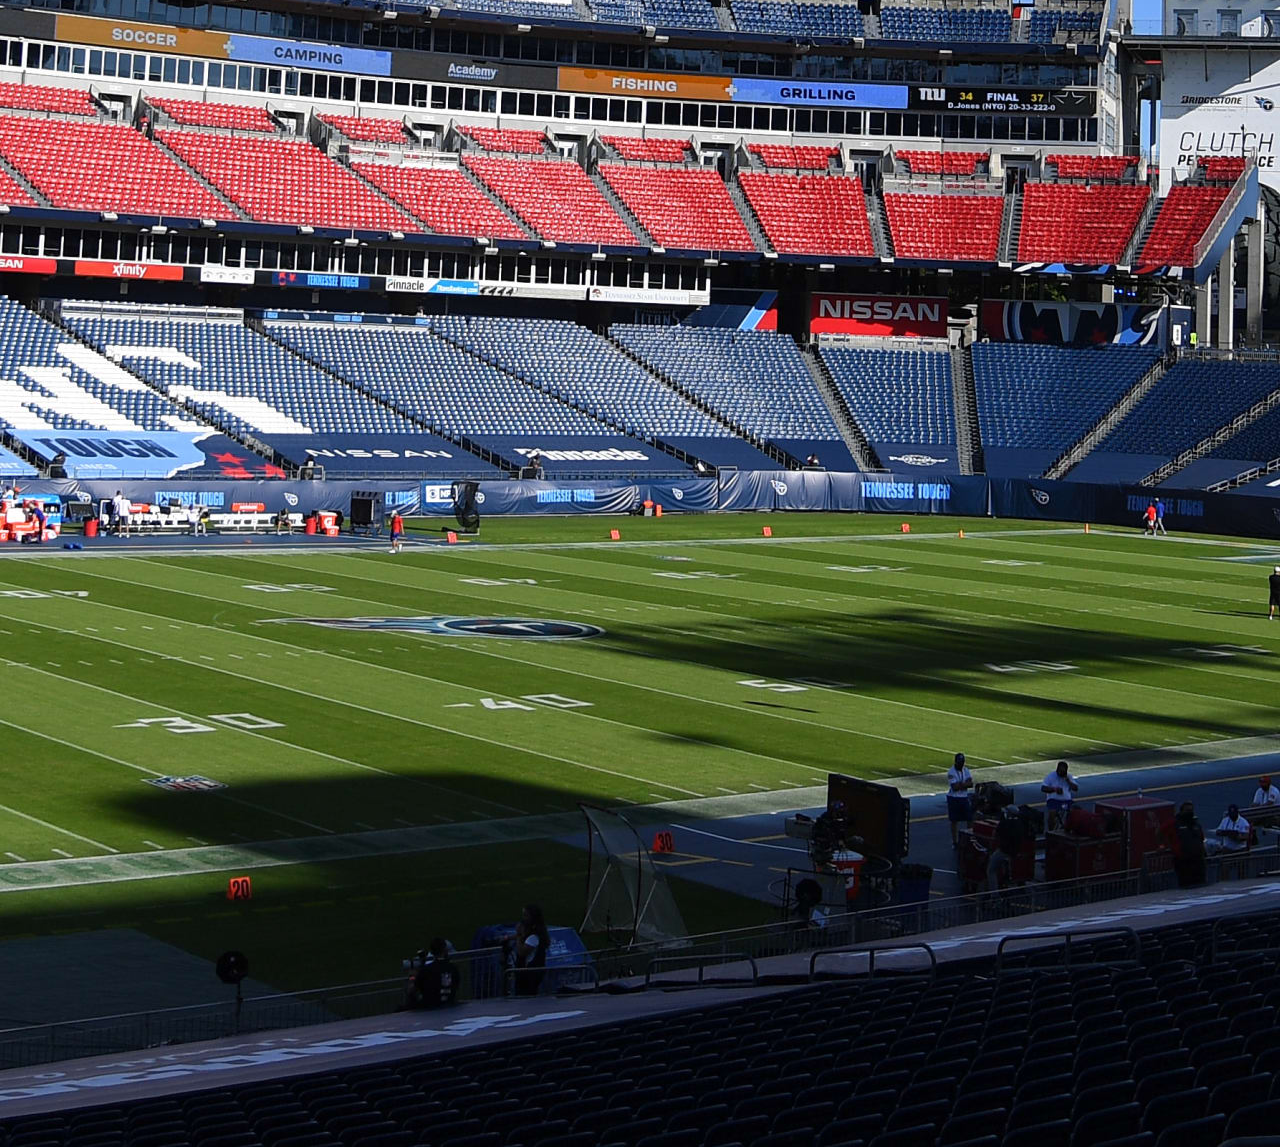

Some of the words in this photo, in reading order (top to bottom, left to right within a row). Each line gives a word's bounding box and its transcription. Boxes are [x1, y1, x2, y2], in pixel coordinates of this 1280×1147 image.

[112, 28, 177, 47] SOCCER
[273, 46, 343, 66] CAMPING
[448, 62, 498, 81] Academy
[612, 77, 677, 93] FISHING
[780, 87, 856, 101] GRILLING
[959, 92, 973, 101] 34
[986, 92, 1019, 102] FINAL
[1030, 93, 1044, 102] 37
[1181, 95, 1243, 105] BRIDGESTONE
[947, 102, 980, 110] D.Jones
[982, 102, 1006, 111] (NYG)
[1008, 103, 1056, 112] 20-33-222-0
[1179, 130, 1276, 154] CLUTCH
[112, 263, 147, 277] xfinity
[307, 274, 339, 287] TENNESSEE
[340, 276, 360, 288] TOUGH
[387, 278, 424, 291] Pinnacle
[819, 299, 940, 323] NISSAN
[32, 436, 178, 458] TOUGH
[304, 448, 453, 459] NISSAN
[514, 447, 650, 462] Pinnacle
[537, 490, 572, 503] TENNESSEE
[860, 481, 915, 499] TENNESSEE
[918, 483, 951, 500] TOUGH
[198, 492, 225, 507] TOUGH
[736, 676, 856, 693] 50
[478, 692, 594, 712] 40
[138, 712, 287, 735] 30
[657, 831, 675, 851] 30
[232, 879, 251, 900] 20
